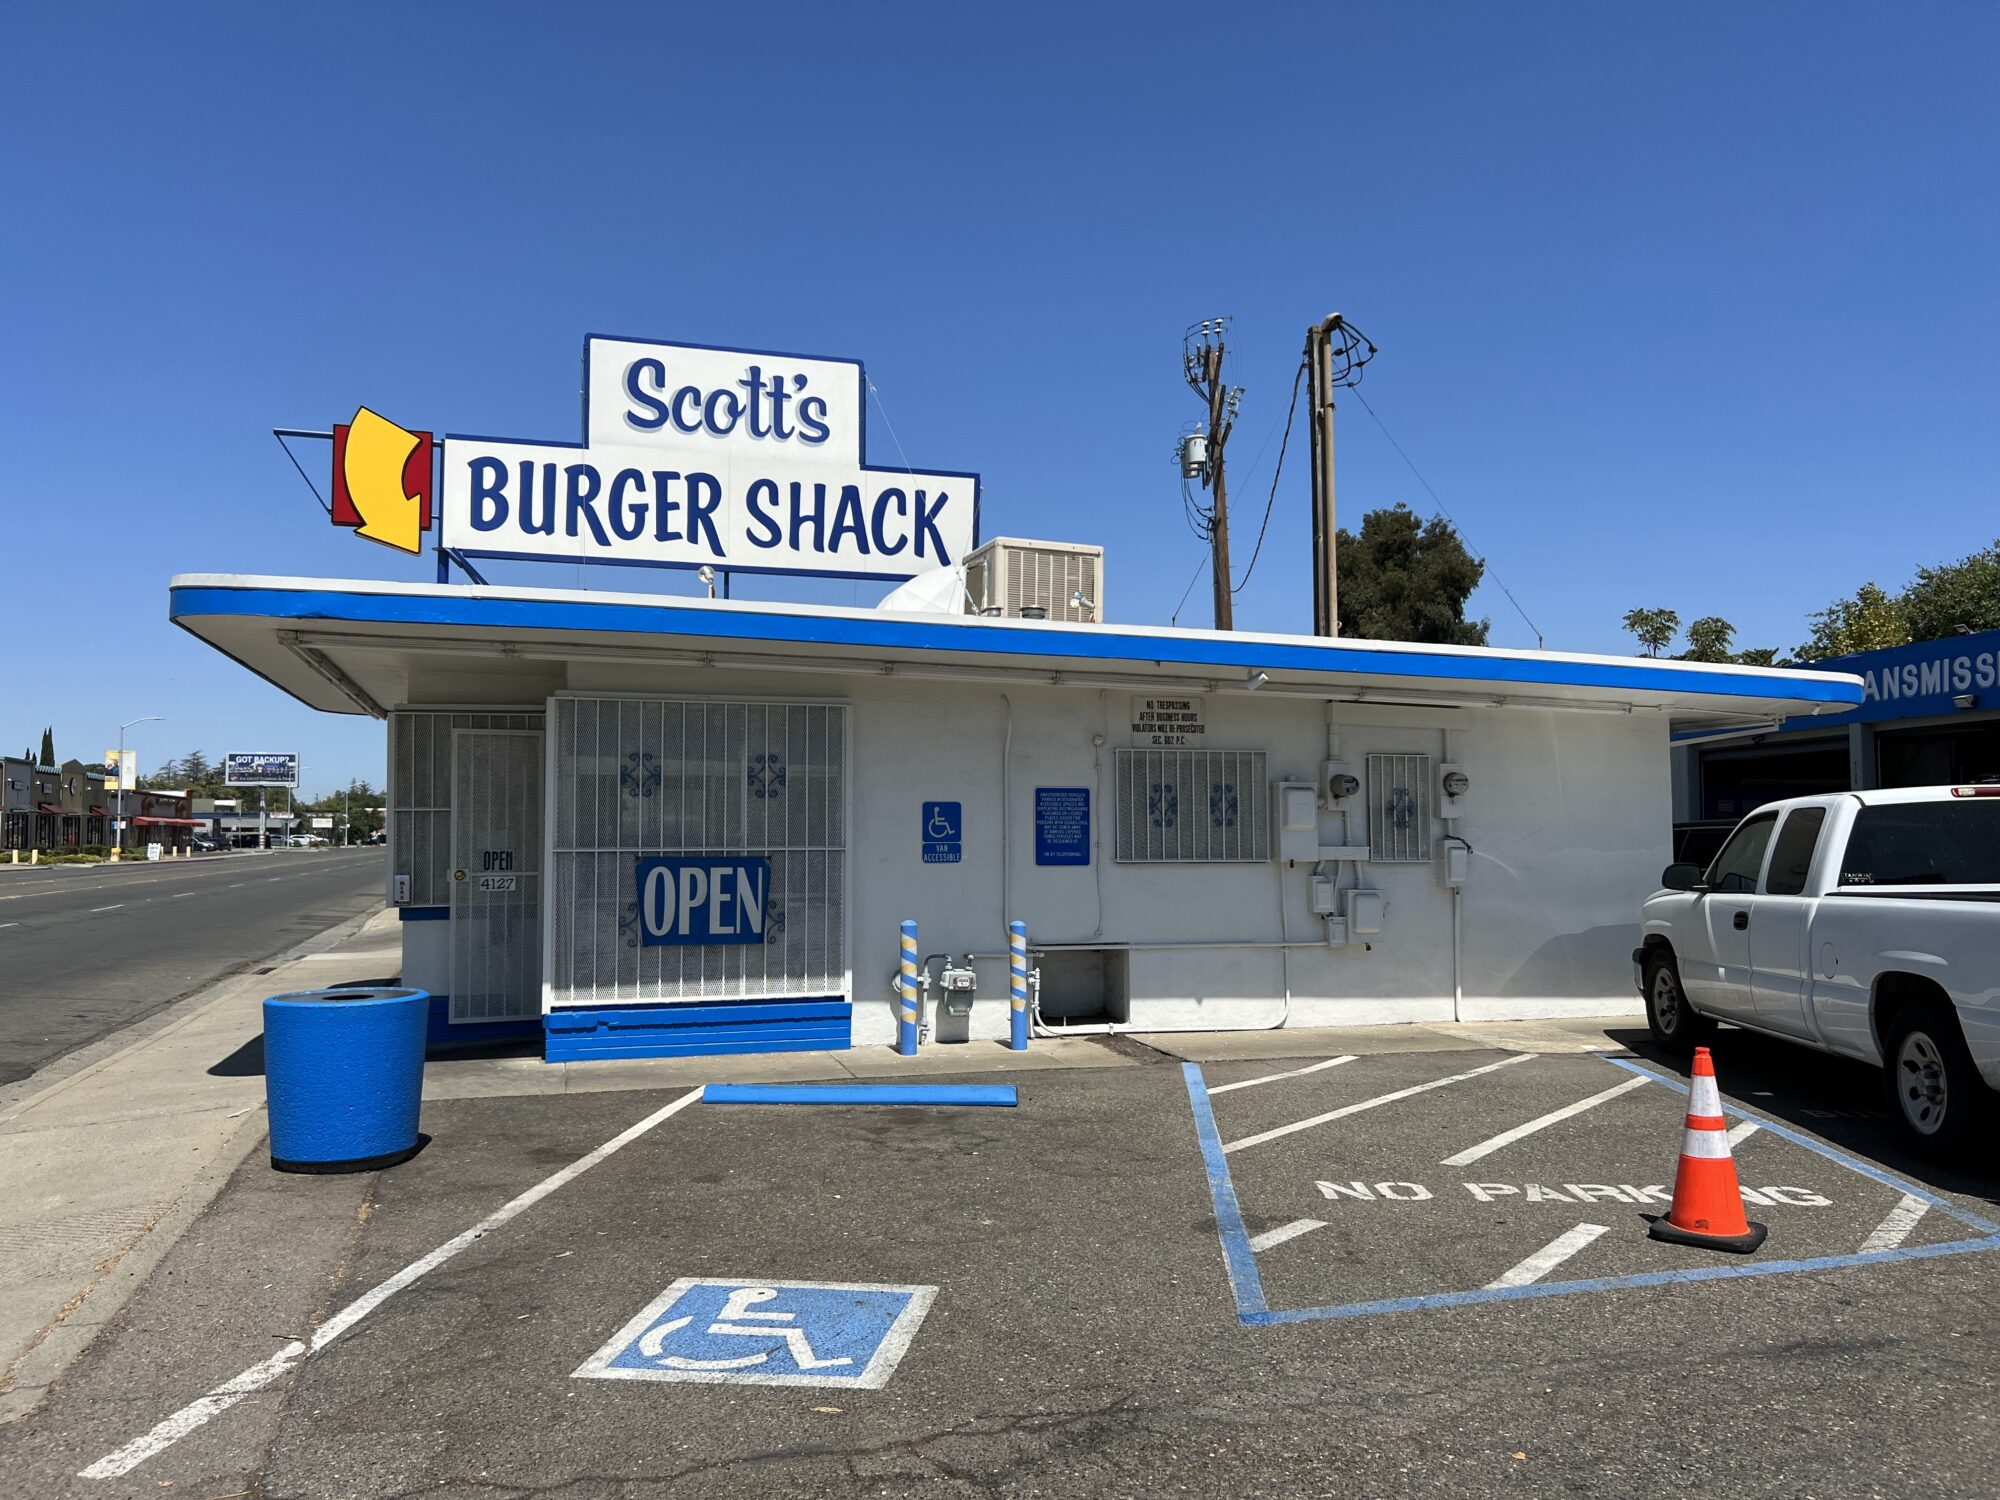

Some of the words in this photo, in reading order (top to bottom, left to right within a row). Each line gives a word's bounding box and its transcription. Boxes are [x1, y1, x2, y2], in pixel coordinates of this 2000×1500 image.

[624, 357, 831, 444] Scott's
[467, 456, 727, 558] BURGER
[746, 478, 952, 567] SHACK
[1146, 700, 1154, 710] NO
[1157, 700, 1190, 710] TRESPASSING
[1139, 712, 1154, 721] AFTER
[1157, 712, 1180, 722] BUSINESS
[1181, 713, 1198, 722] HOURS
[1132, 723, 1156, 733] VIOLATORS
[1157, 724, 1168, 733] WILL
[1169, 724, 1175, 733] BE
[1176, 724, 1205, 734] PROSECUTED
[1152, 735, 1162, 745] SEC.
[254, 756, 290, 764] BACKUP?
[936, 844, 948, 852] VAN
[484, 851, 513, 871] OPEN
[924, 853, 960, 862] ACCESSIBLE
[481, 877, 514, 890] 4127
[644, 866, 763, 937] OPEN
[1314, 1181, 1434, 1200] NO
[1463, 1183, 1834, 1207] PARKNG
